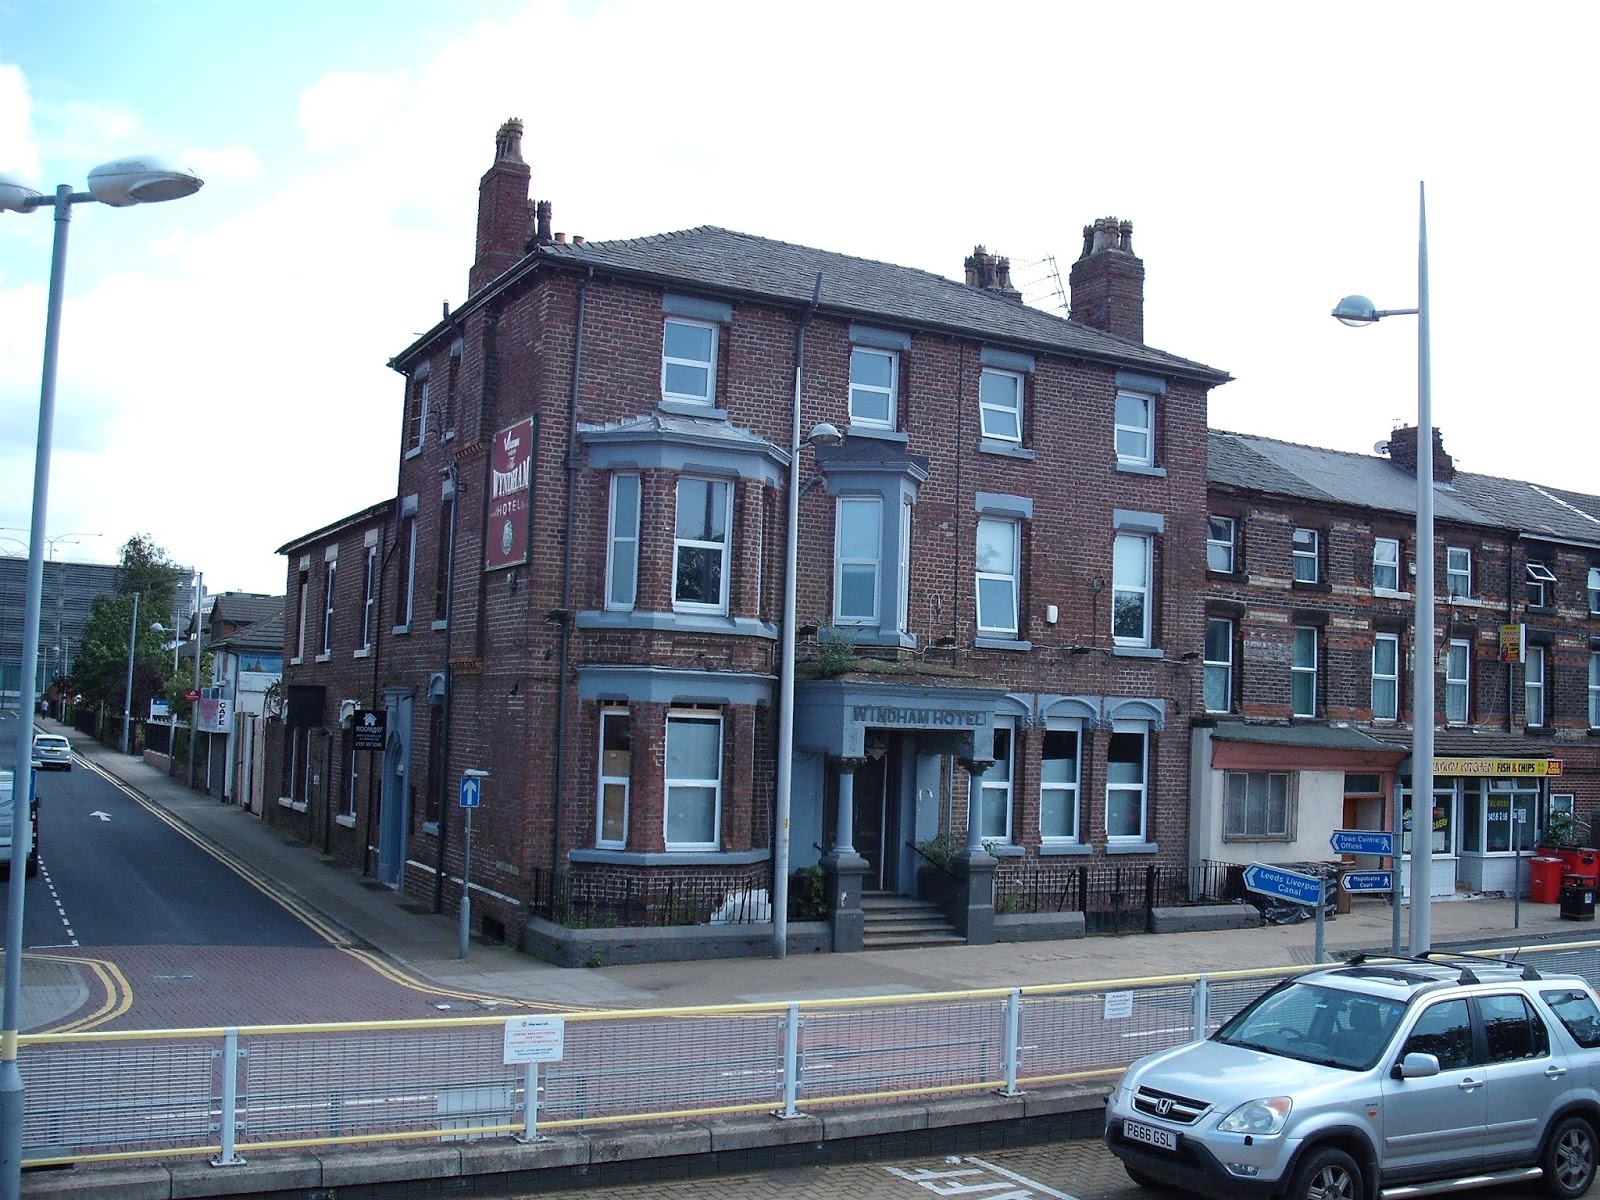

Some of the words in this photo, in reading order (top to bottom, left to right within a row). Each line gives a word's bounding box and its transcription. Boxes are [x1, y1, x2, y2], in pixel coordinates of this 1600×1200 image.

[493, 452, 530, 499] WYNDHAM
[497, 499, 520, 516] HOTEL
[218, 702, 226, 726] CAFE
[933, 711, 984, 726] HOTEL
[1496, 762, 1511, 772] FISH
[1512, 762, 1517, 772] &
[1518, 763, 1535, 773] CHIPS
[1340, 842, 1363, 850] Offices
[1341, 835, 1356, 843] Town
[1358, 835, 1379, 844] Centre
[1260, 871, 1284, 883] Leeds
[1278, 884, 1302, 896] Canal
[1127, 1122, 1152, 1142] P666
[1153, 1130, 1172, 1148] GSL
